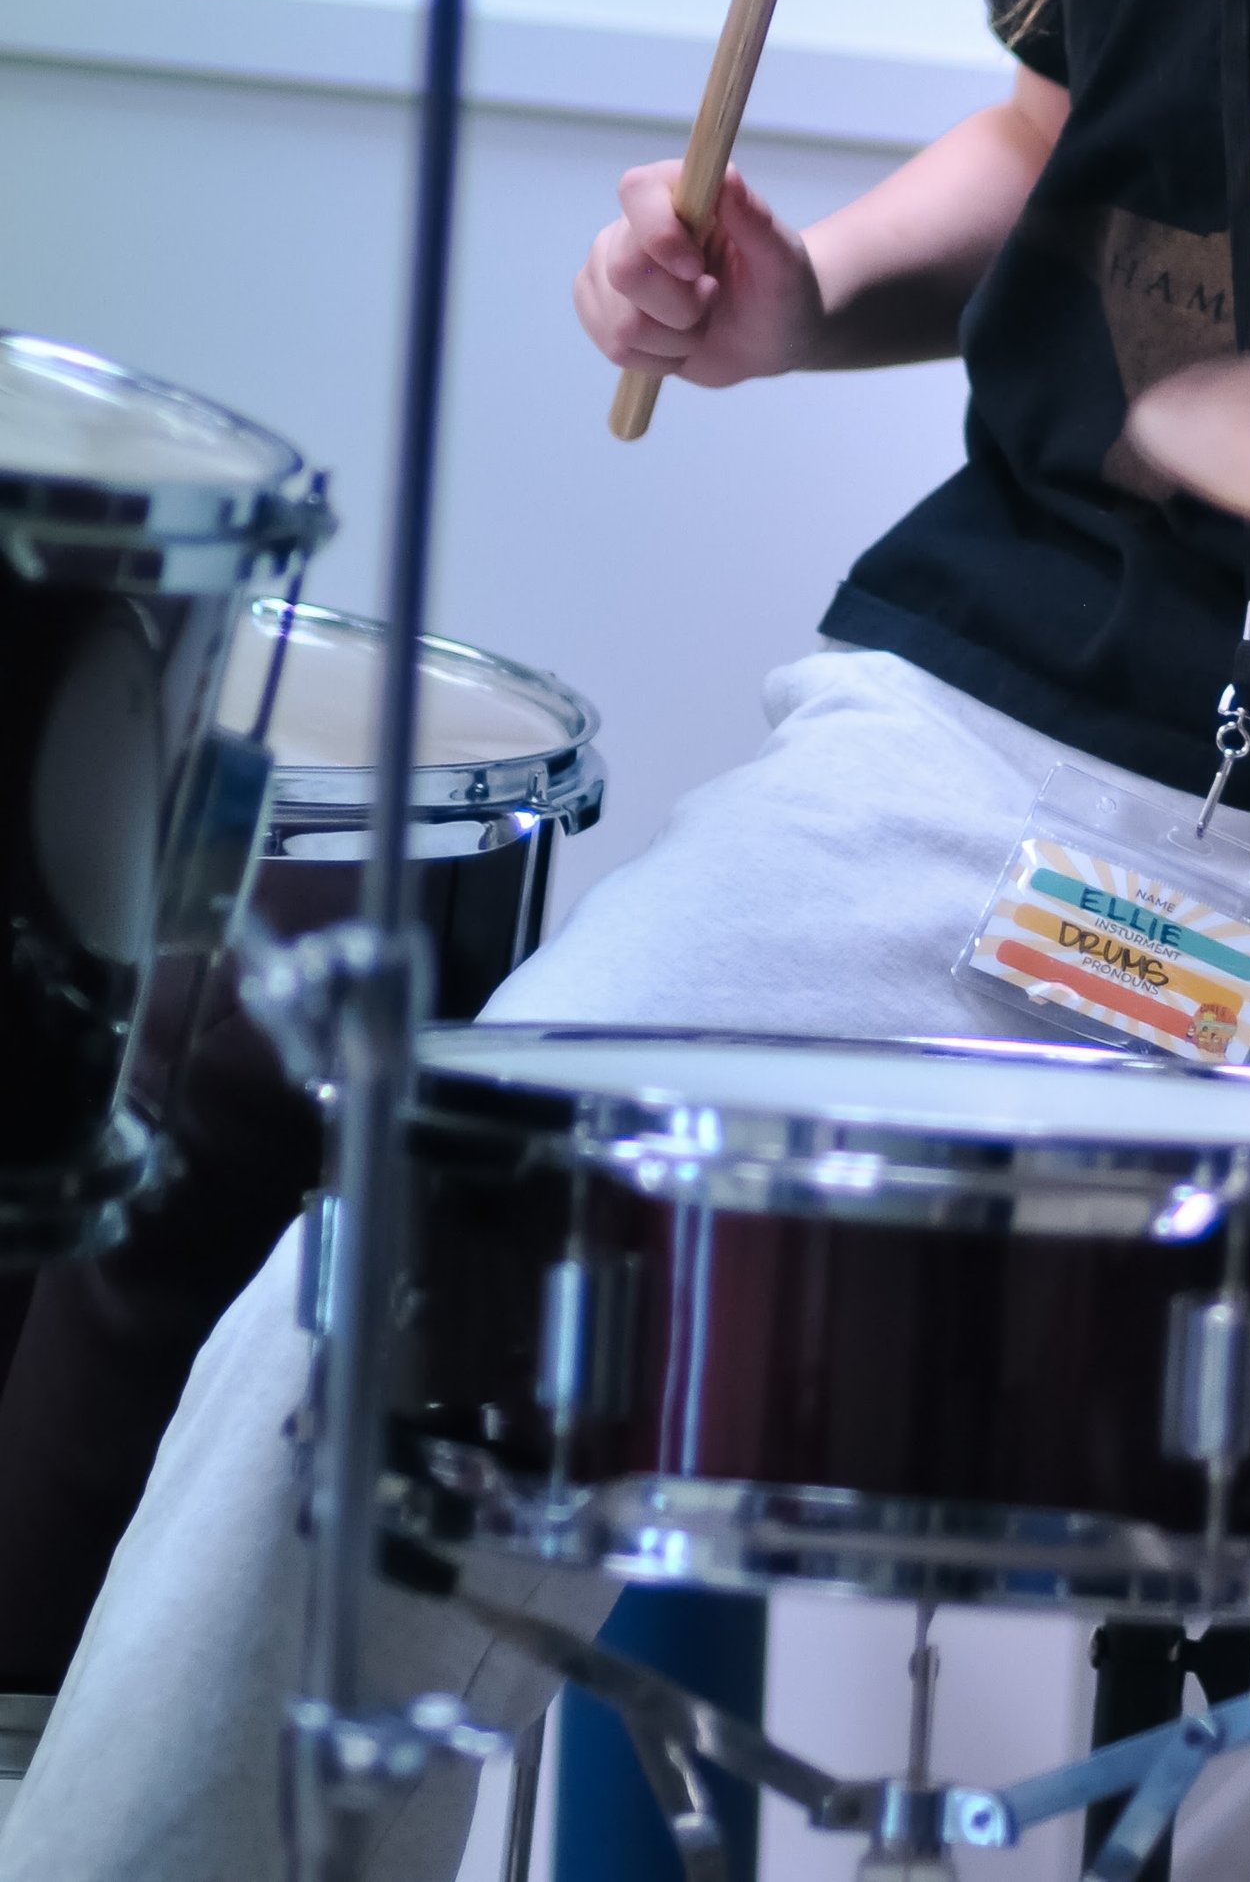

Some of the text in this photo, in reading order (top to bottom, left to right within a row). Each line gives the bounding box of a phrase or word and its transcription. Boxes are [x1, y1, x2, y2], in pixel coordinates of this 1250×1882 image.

[1081, 887, 1182, 947] ELLIE
[1136, 889, 1176, 913] NAME
[1059, 921, 1169, 987] DRUMS
[1095, 918, 1182, 961] INSTURMENT
[1082, 956, 1159, 995] PRONOUNS
